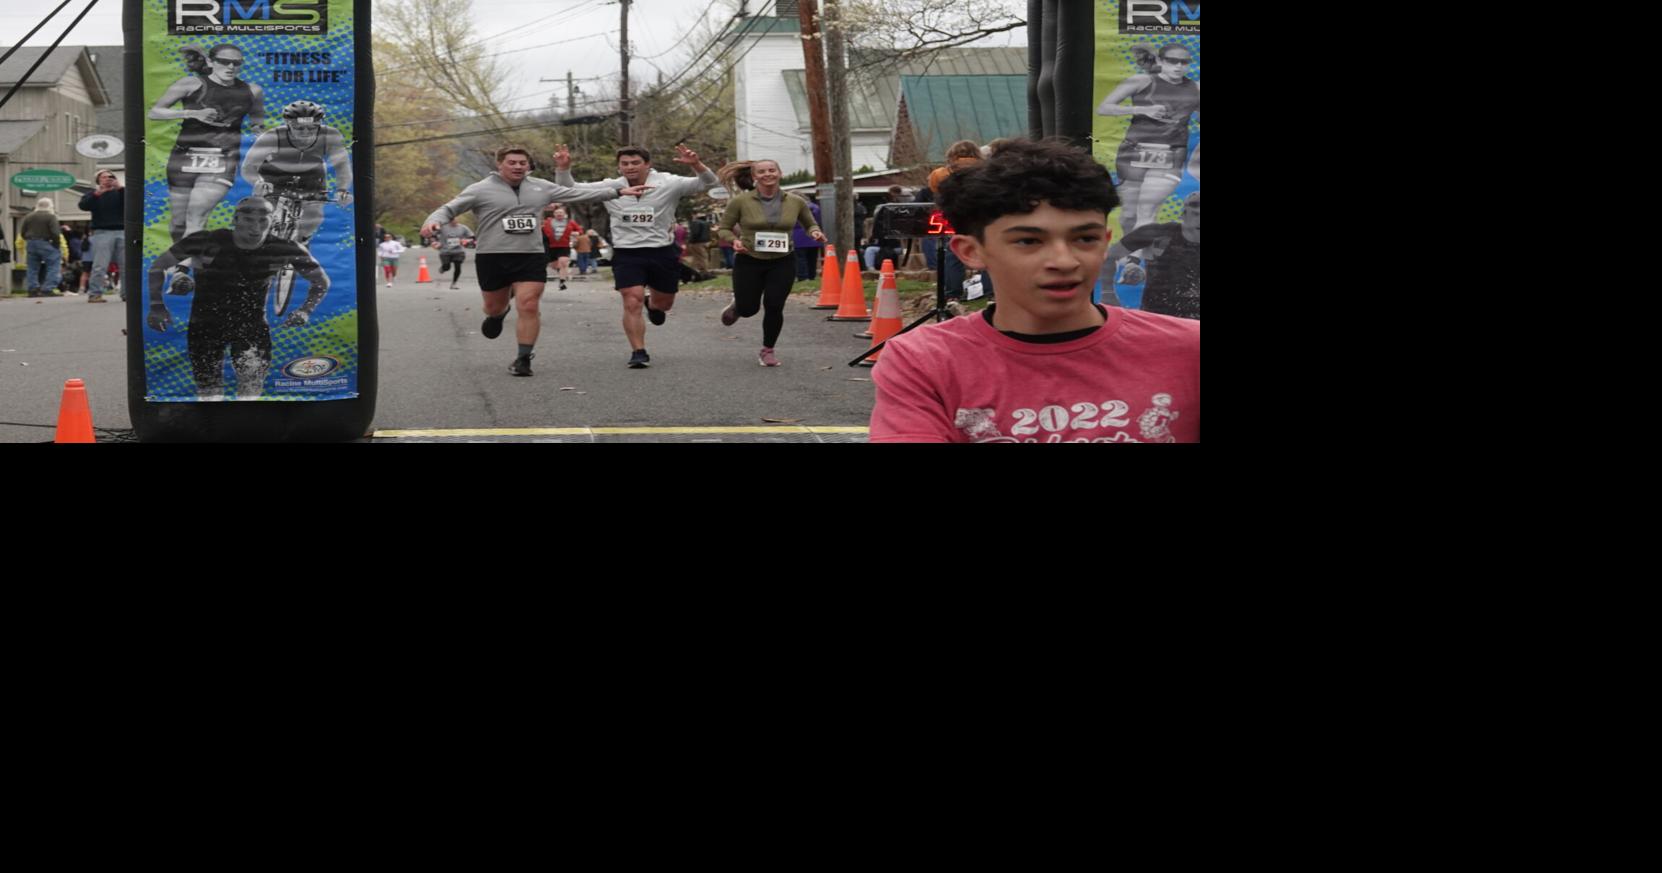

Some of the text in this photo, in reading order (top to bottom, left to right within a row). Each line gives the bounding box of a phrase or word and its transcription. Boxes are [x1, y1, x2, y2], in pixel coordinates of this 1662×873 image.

[176, 0, 320, 25] RMS
[258, 53, 331, 65] "FITNESS
[273, 70, 347, 83] FOR LIFE"
[1139, 151, 1167, 163] 173
[507, 218, 534, 229] 964
[632, 214, 653, 223] 292
[768, 239, 786, 248] 291
[1010, 400, 1130, 436] 2022
